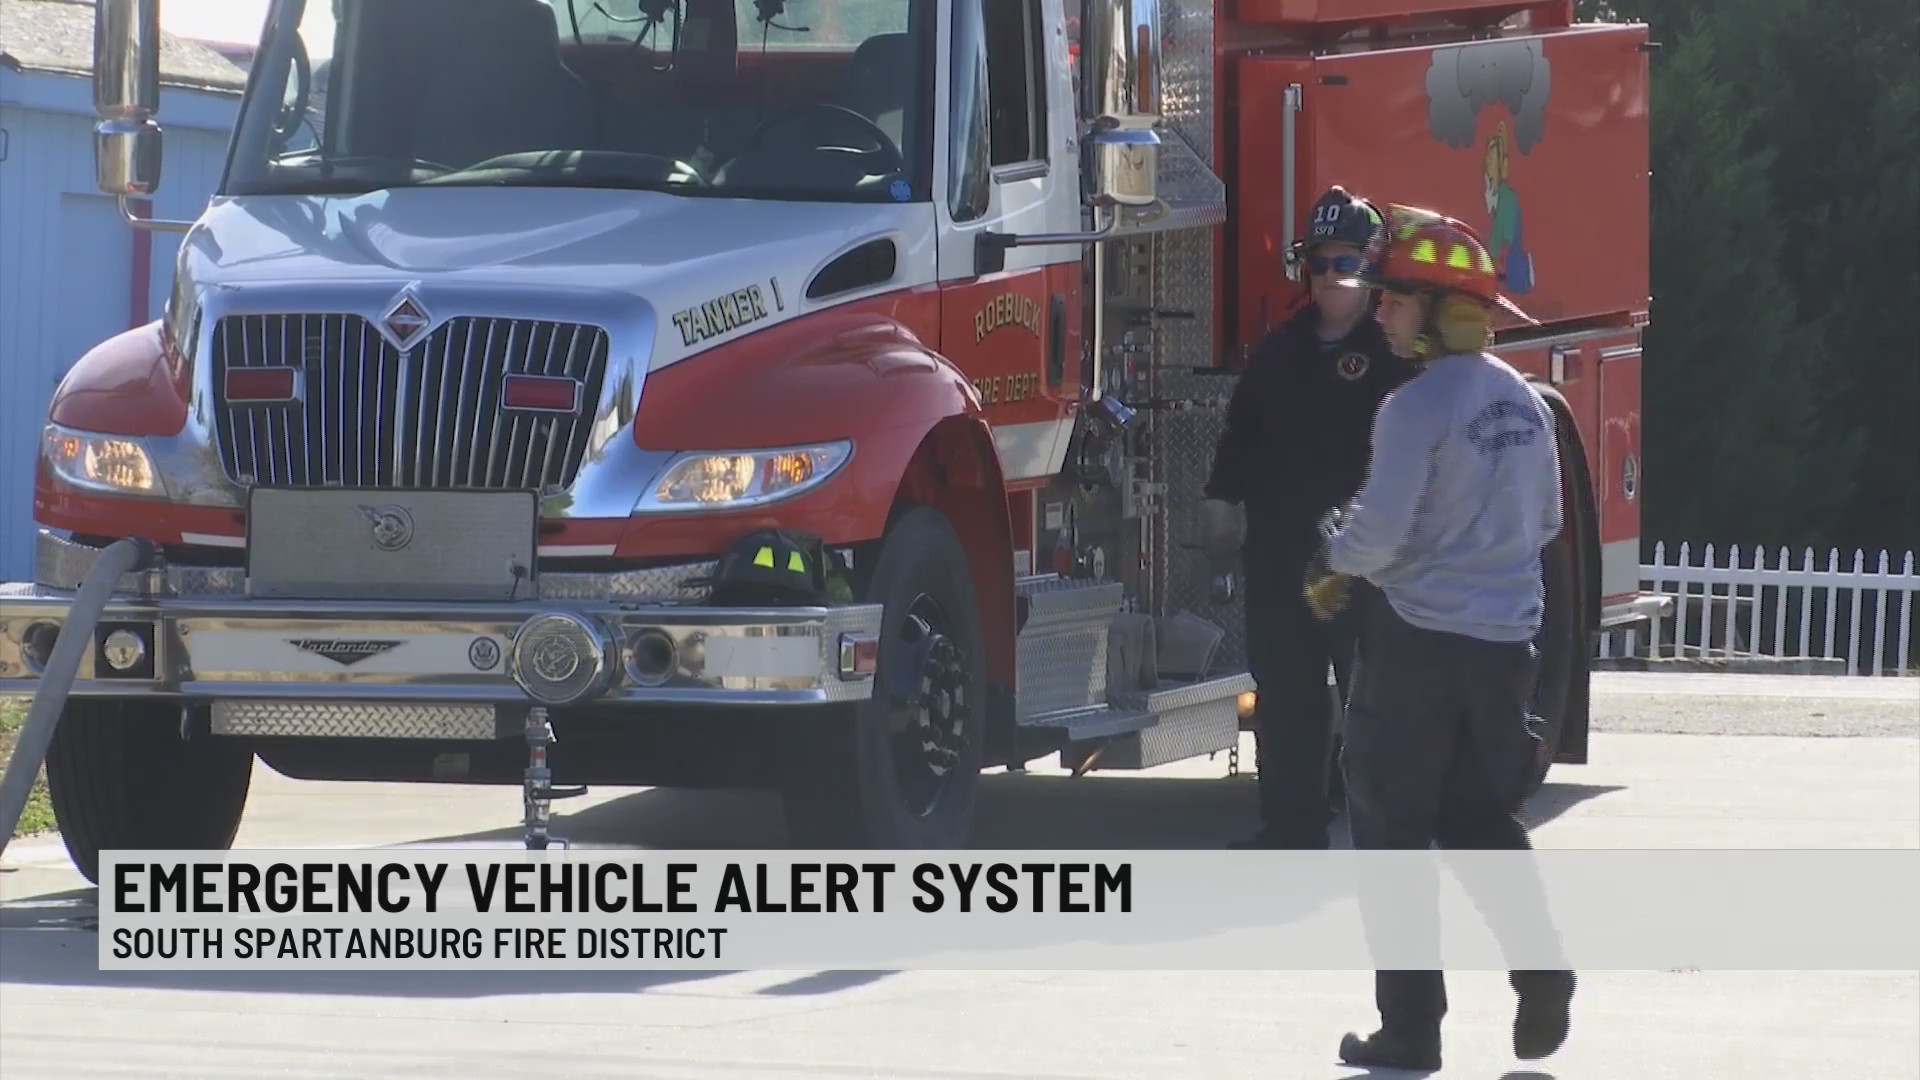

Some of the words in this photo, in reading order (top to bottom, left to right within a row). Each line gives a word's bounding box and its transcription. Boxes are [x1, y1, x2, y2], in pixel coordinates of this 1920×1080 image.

[1314, 204, 1341, 223] 10
[672, 284, 768, 347] TANKER
[974, 292, 1041, 345] ROEBUCK
[1004, 372, 1038, 404] DEPT
